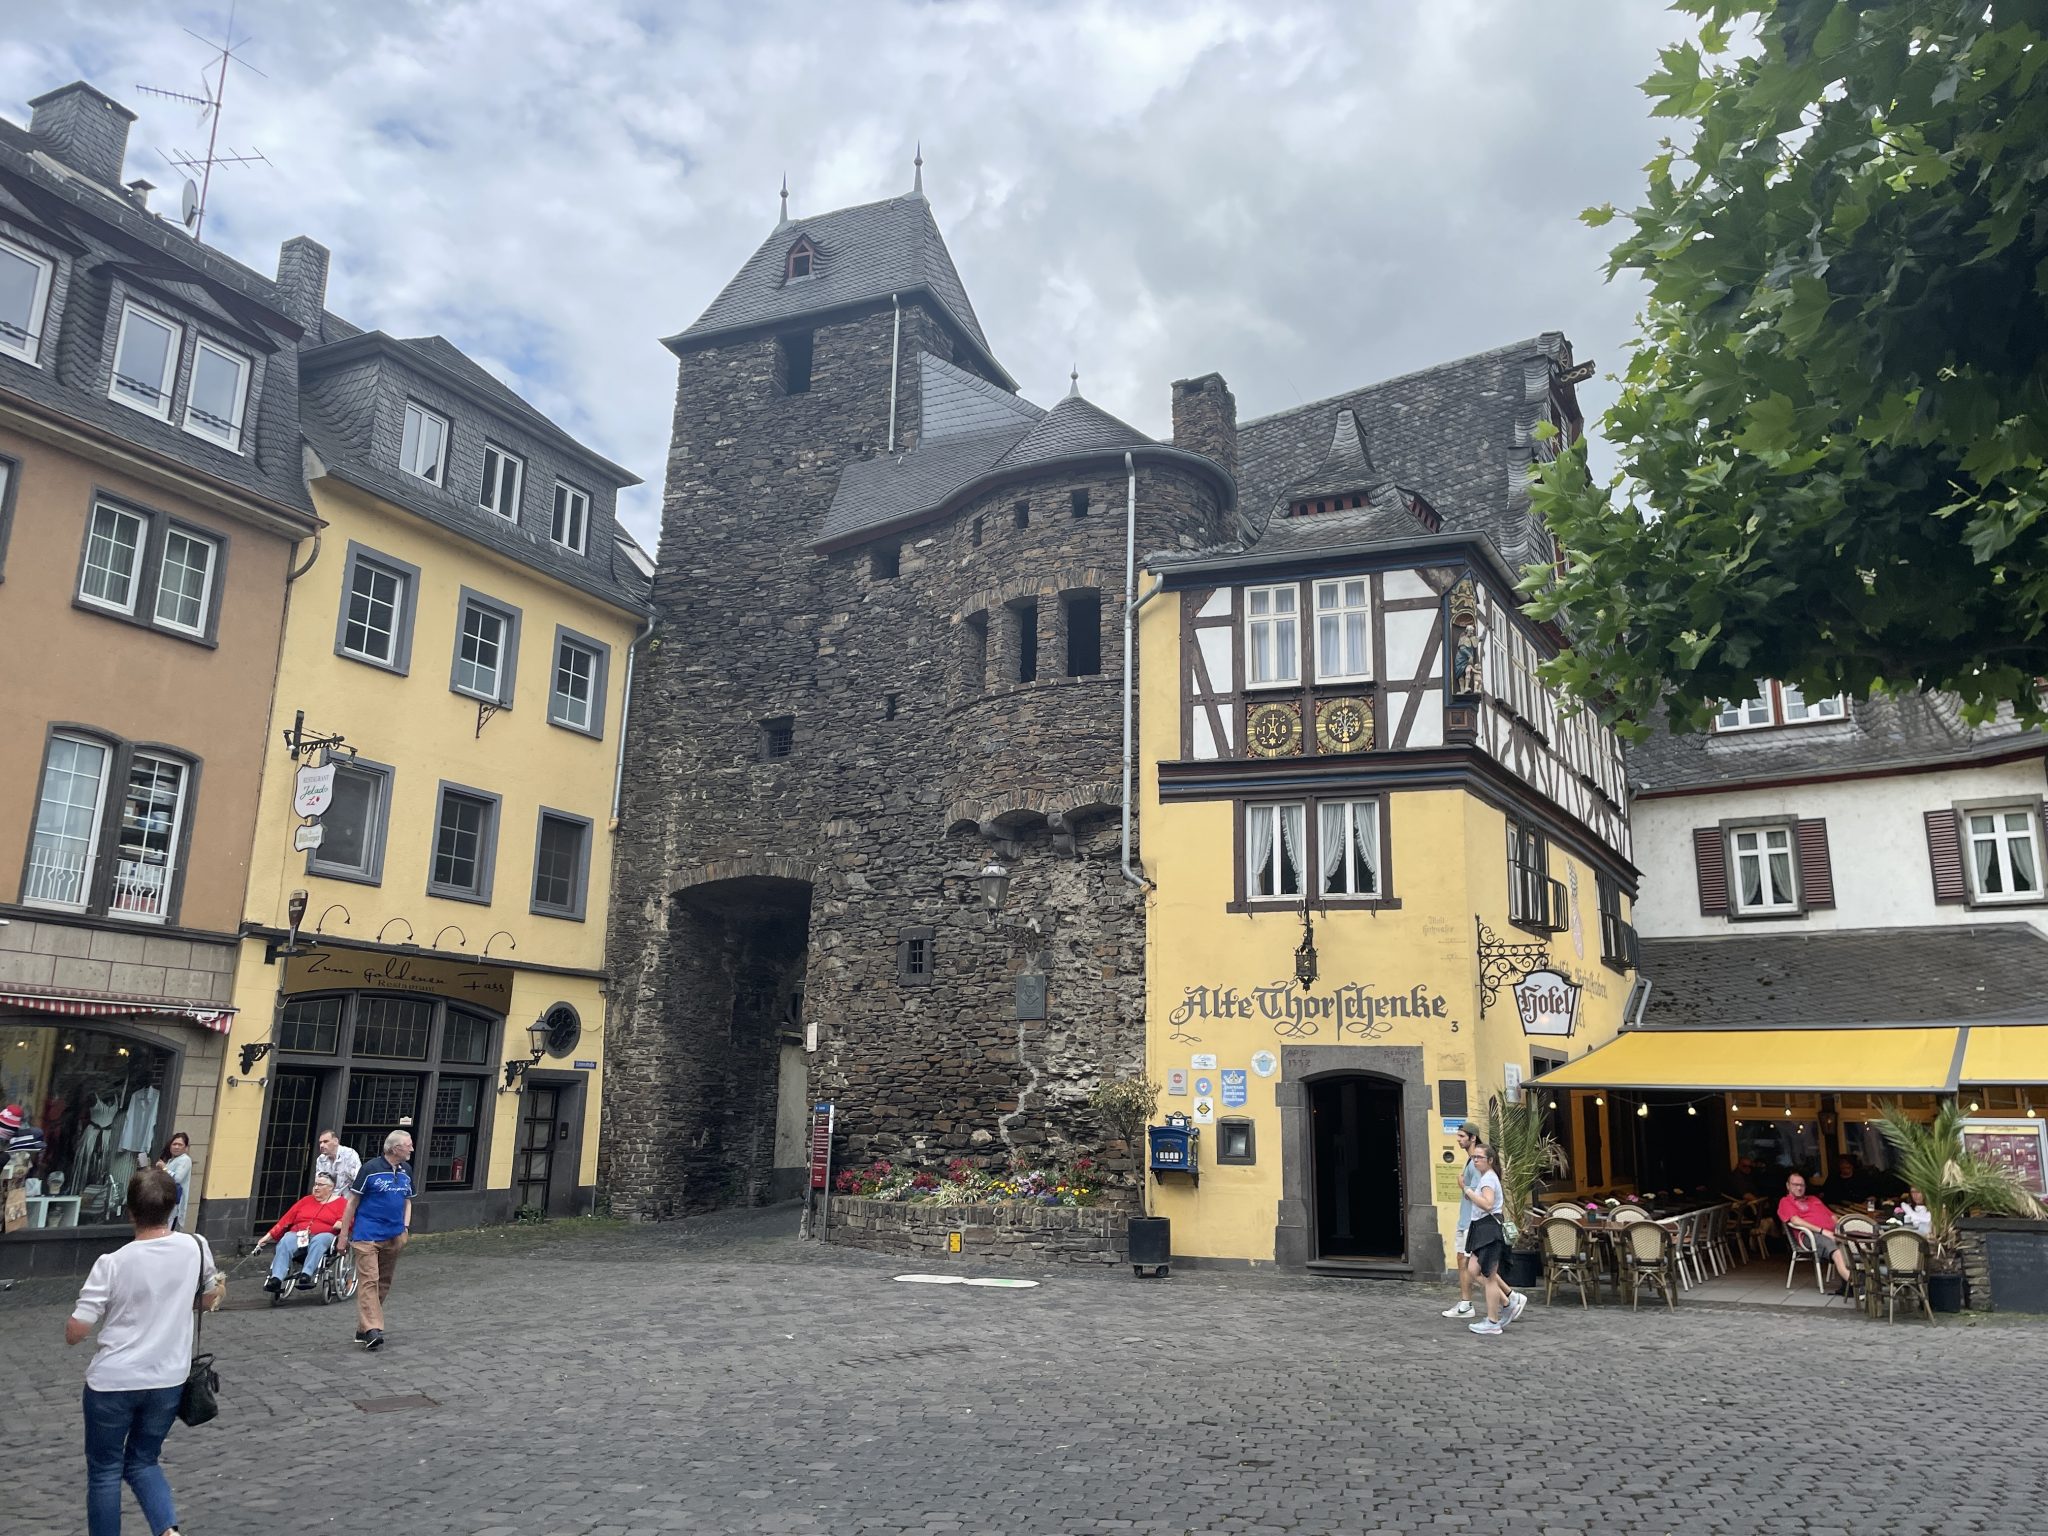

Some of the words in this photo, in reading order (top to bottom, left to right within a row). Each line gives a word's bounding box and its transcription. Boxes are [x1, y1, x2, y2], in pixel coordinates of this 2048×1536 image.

[1257, 726, 1265, 734] M
[1281, 725, 1287, 734] B
[296, 953, 353, 974] Zum
[457, 972, 506, 993] Fass
[377, 979, 435, 992] Restaurant
[1169, 983, 1254, 1030] Alte
[1518, 985, 1573, 1023] Hotel
[1451, 1021, 1459, 1033] 3
